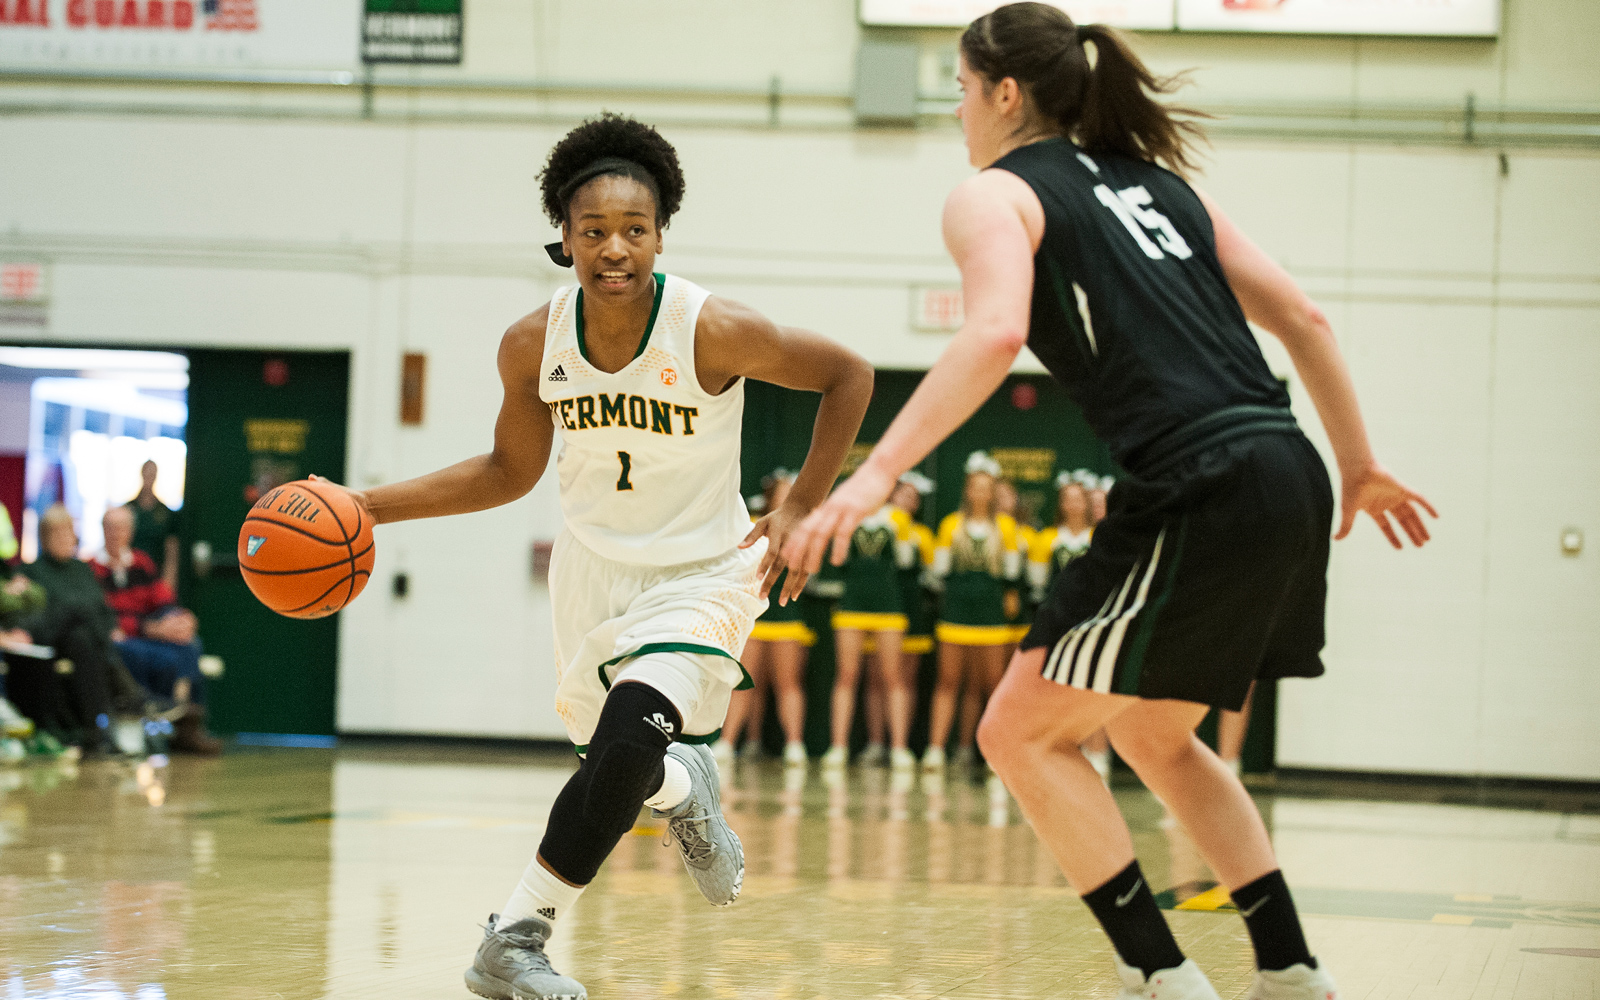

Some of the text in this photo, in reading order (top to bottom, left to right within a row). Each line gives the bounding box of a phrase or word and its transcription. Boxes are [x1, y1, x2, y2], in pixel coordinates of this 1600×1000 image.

[66, 0, 193, 29] GUARD
[1093, 184, 1193, 260] 15
[662, 371, 676, 384] PS
[616, 451, 633, 491] 1
[277, 493, 320, 523] THE
